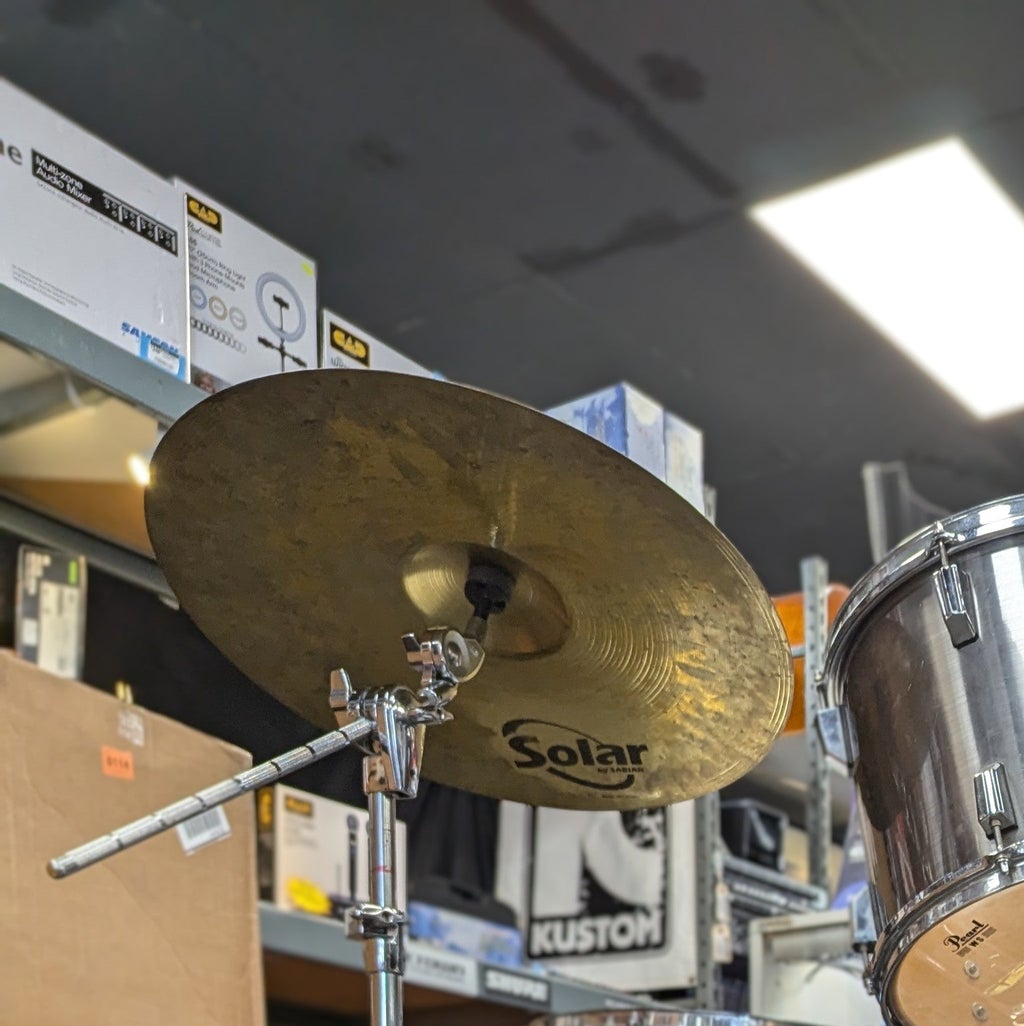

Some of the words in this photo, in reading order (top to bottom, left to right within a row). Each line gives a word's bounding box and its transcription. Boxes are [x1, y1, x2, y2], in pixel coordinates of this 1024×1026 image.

[35, 154, 84, 190] Multi-zone
[36, 167, 65, 190] Audio
[66, 183, 92, 204] Mixer
[333, 329, 367, 359] CAD
[508, 734, 649, 769] Solar
[532, 910, 662, 954] KUSTOM
[943, 919, 985, 953] Pearl
